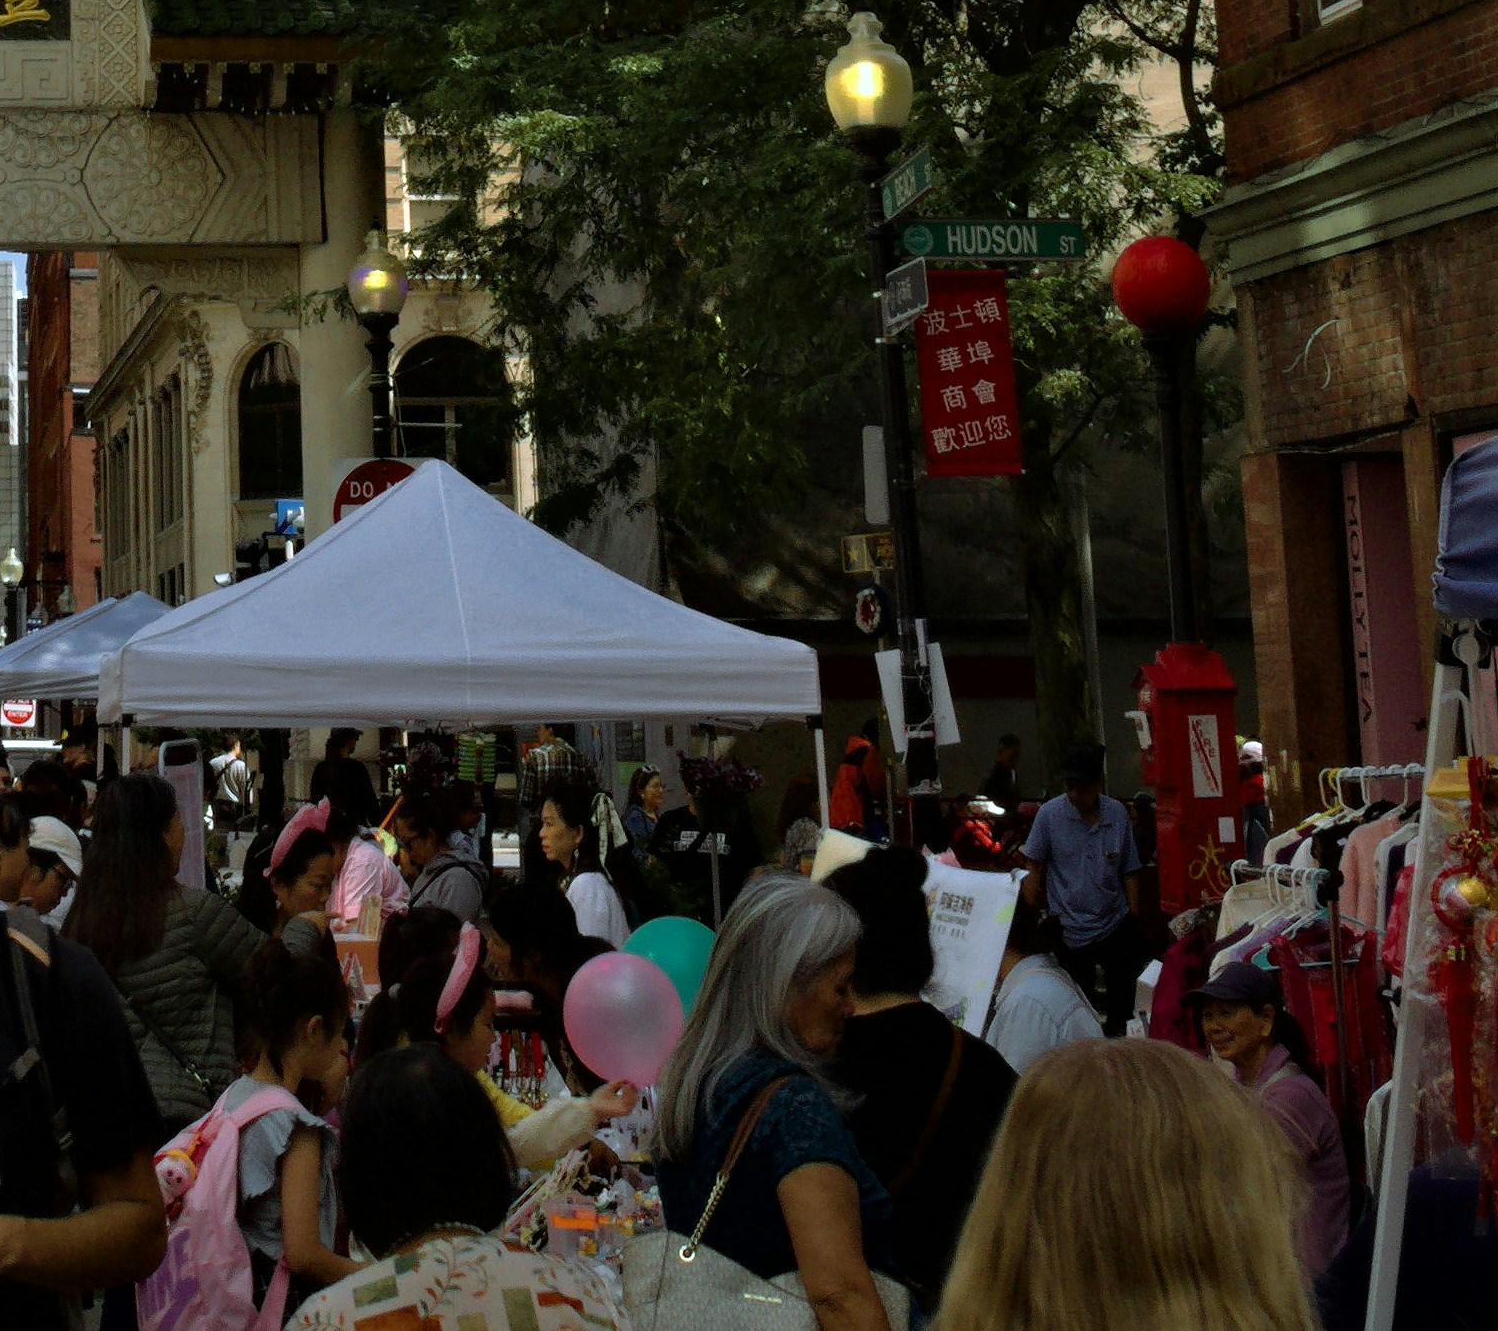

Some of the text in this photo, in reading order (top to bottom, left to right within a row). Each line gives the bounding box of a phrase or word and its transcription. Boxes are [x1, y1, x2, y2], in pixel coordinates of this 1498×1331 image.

[946, 224, 1077, 255] HUDSON ST
[922, 297, 1002, 336] 波士頓
[936, 339, 995, 373] 華埠
[939, 379, 997, 413] 商會
[930, 414, 1012, 454] 歡迎您
[350, 480, 374, 499] DO
